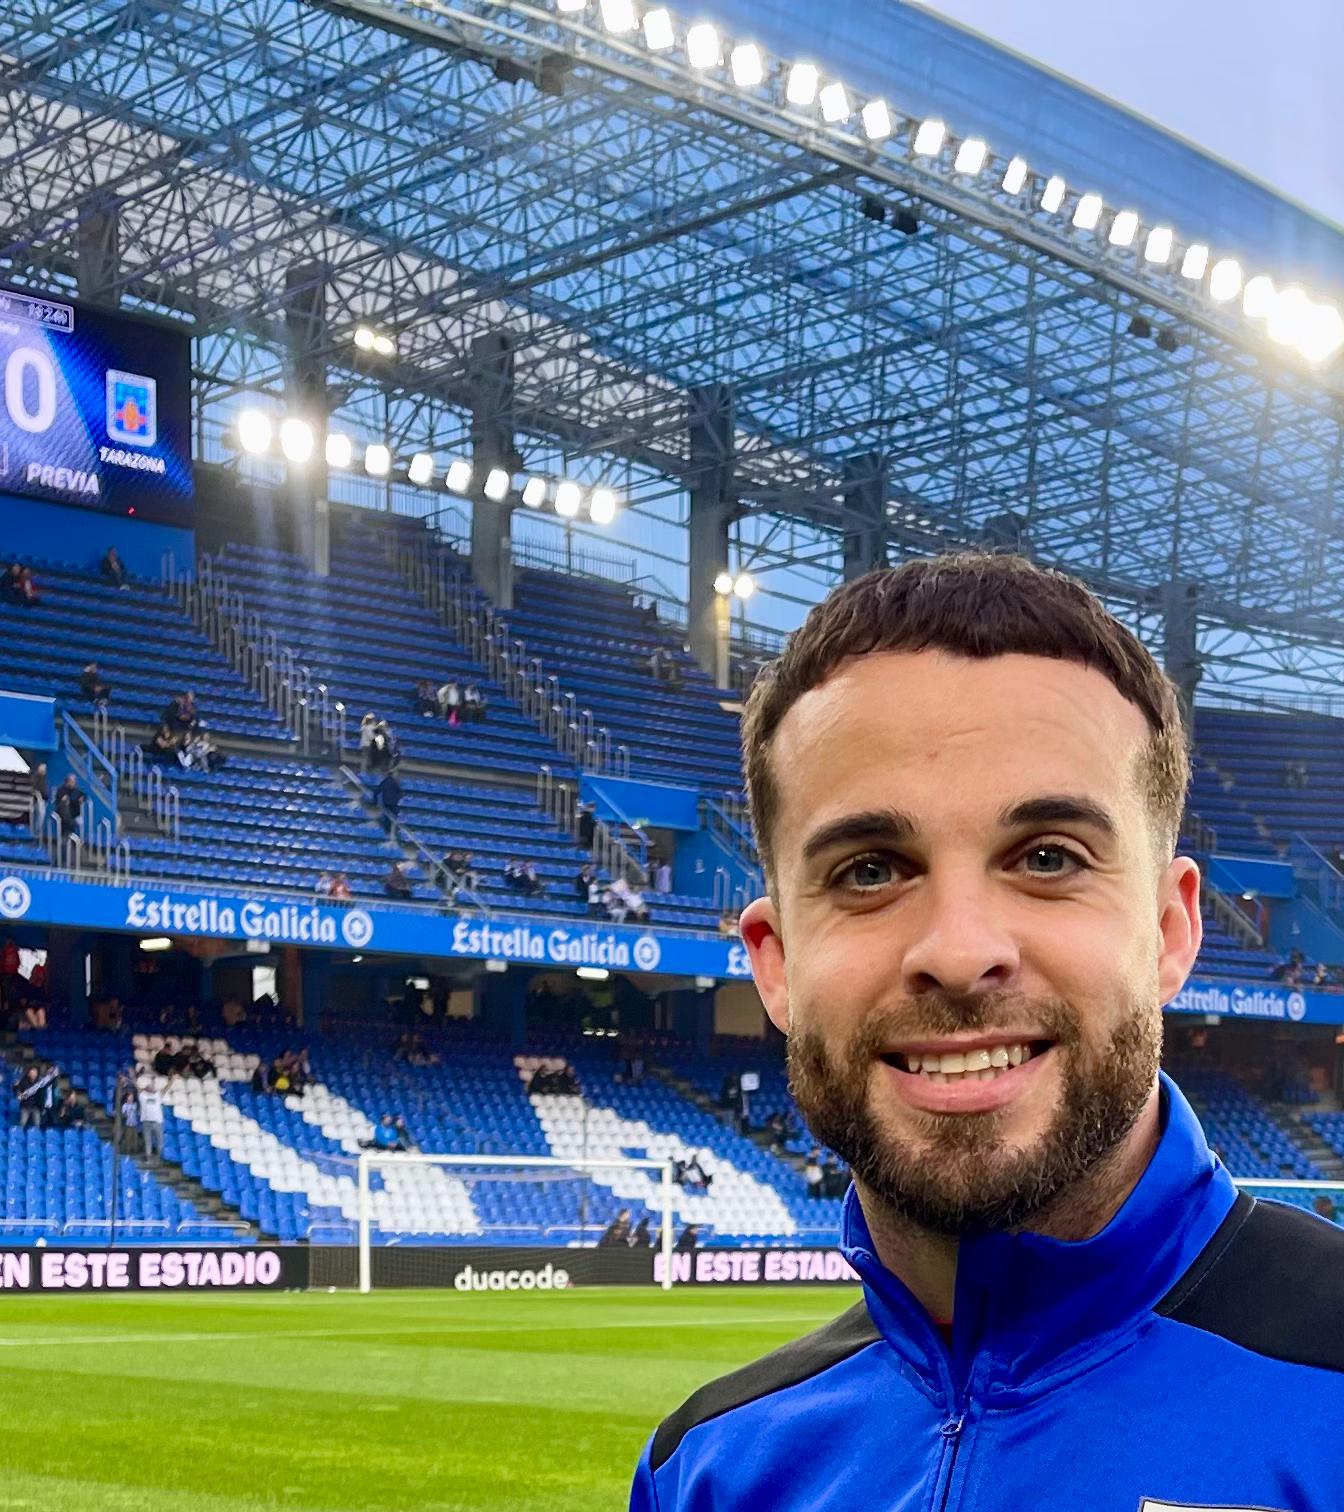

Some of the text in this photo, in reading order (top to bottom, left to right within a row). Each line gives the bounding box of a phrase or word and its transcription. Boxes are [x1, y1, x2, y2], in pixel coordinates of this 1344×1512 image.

[4, 346, 56, 433] 0
[98, 445, 167, 475] TARAZONA
[26, 461, 100, 495] PREVIA
[126, 892, 337, 942] Estrella Galicia
[452, 920, 629, 968] Estrella Galicia
[1231, 987, 1285, 1017] Galicia
[41, 1252, 130, 1288] ESTE
[139, 1251, 281, 1287] ESTADIO
[454, 1263, 569, 1291] duacode
[695, 1251, 760, 1282] ESTE
